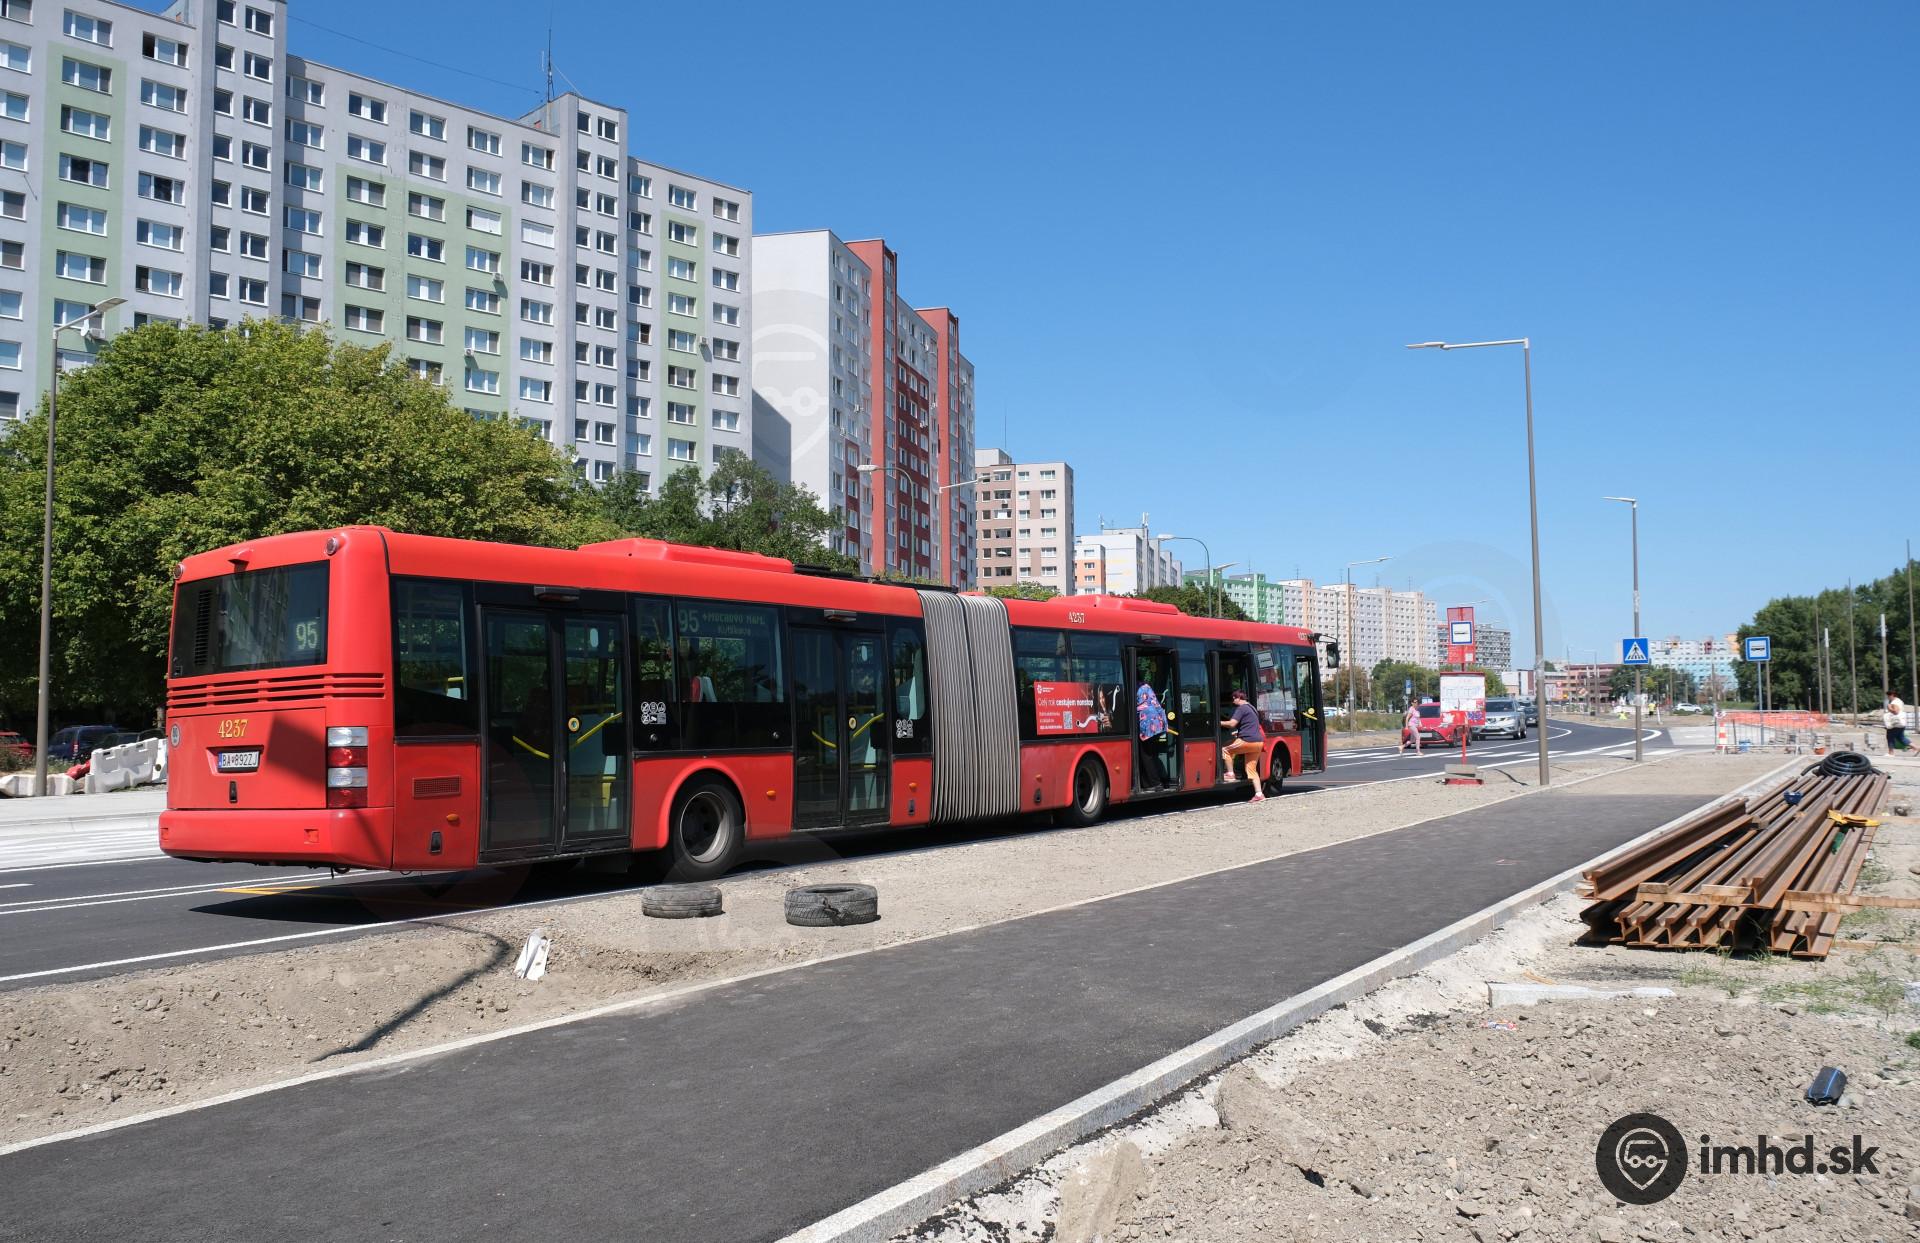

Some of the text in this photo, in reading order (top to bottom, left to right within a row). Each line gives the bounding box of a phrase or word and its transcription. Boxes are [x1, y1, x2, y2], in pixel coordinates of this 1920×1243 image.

[678, 608, 700, 632] 95
[1068, 611, 1085, 624] 4237
[296, 621, 318, 650] 95
[217, 719, 248, 738] 4237
